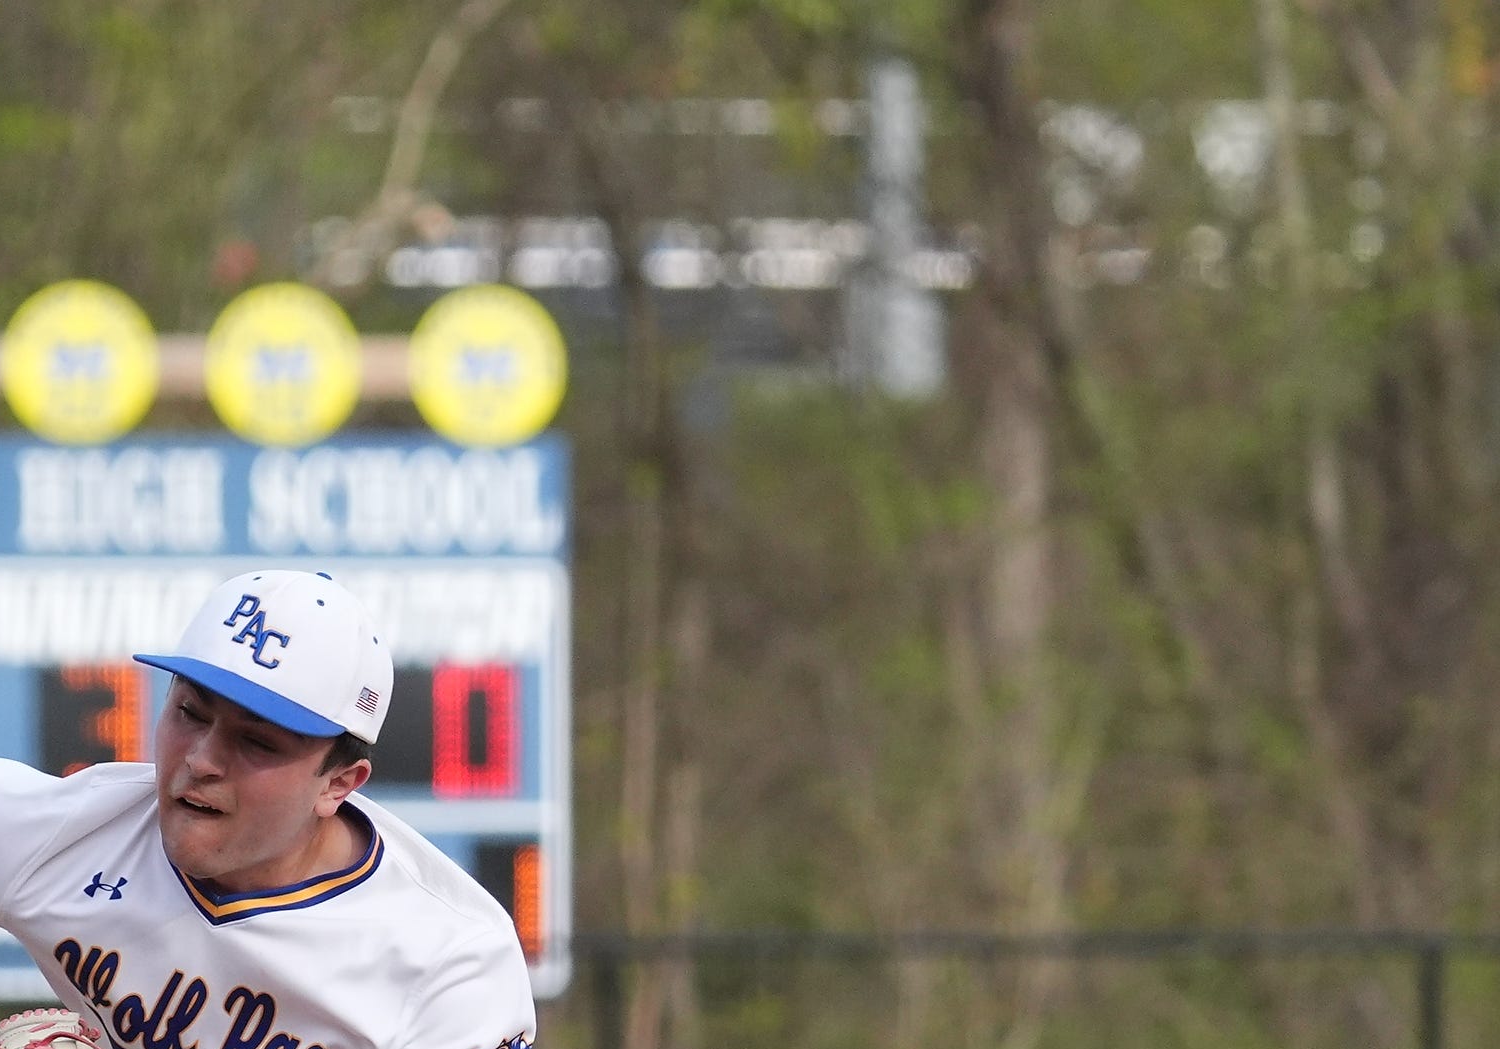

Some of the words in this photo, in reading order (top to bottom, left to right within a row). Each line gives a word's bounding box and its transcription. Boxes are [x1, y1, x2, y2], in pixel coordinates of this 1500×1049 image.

[18, 445, 225, 553] HIGH
[247, 446, 564, 555] SCHOOL
[223, 593, 291, 670] PAC
[432, 657, 520, 798] 0
